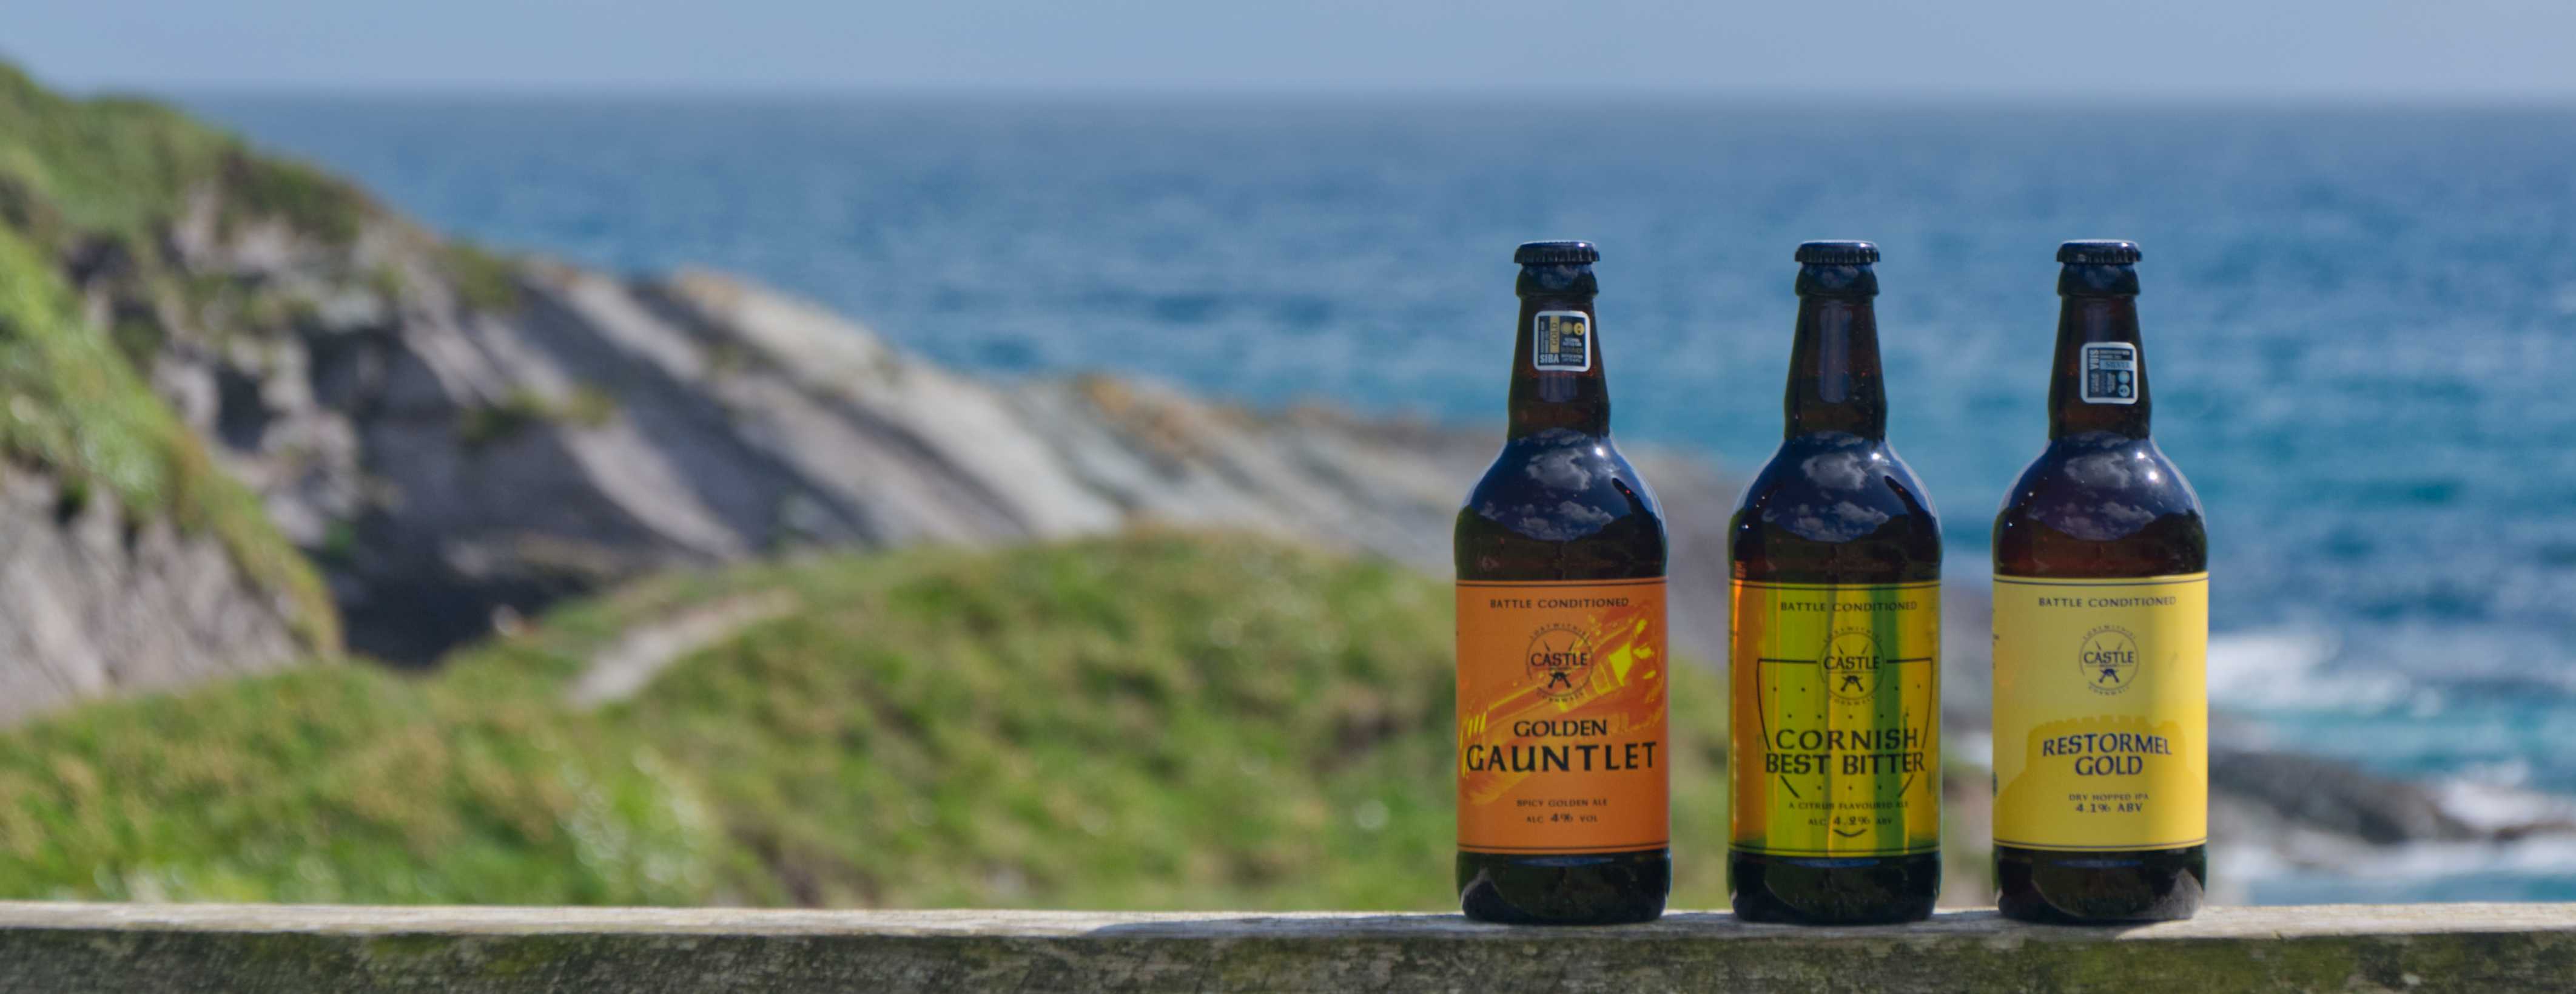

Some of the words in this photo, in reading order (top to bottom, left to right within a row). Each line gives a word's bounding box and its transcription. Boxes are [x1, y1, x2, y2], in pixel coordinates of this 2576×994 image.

[1539, 354, 1559, 363] SIBA
[1490, 599, 1532, 609] BATTLE
[1538, 598, 1629, 609] CONDITIONED
[1780, 602, 1826, 612] BATTLE
[1832, 601, 1917, 612] CONDITIONED
[2039, 597, 2082, 607] BATTLE
[2088, 597, 2176, 608] CONDITIONED
[1530, 653, 1587, 666] CASTLE
[1824, 656, 1880, 670] CASTLE
[2083, 651, 2134, 664] CASTLE
[1513, 719, 1607, 737] GOLDEN
[1775, 728, 1919, 751] CORNISH
[2042, 733, 2172, 757] RESTORMEL
[1467, 742, 1657, 773] GAUNTLET
[1766, 753, 1831, 775] BEST
[1843, 752, 1926, 776] BITTER
[2075, 755, 2143, 776] GOLD
[1548, 799, 1589, 807] GOLDEN
[1592, 798, 1608, 806] ALE
[1838, 802, 1893, 810] FLAVOURED
[2075, 803, 2111, 813] 4.1%
[2117, 802, 2144, 813] ABV
[1526, 815, 1544, 823] ALC
[1550, 813, 1573, 823] 4%
[1579, 814, 1598, 823] VOL
